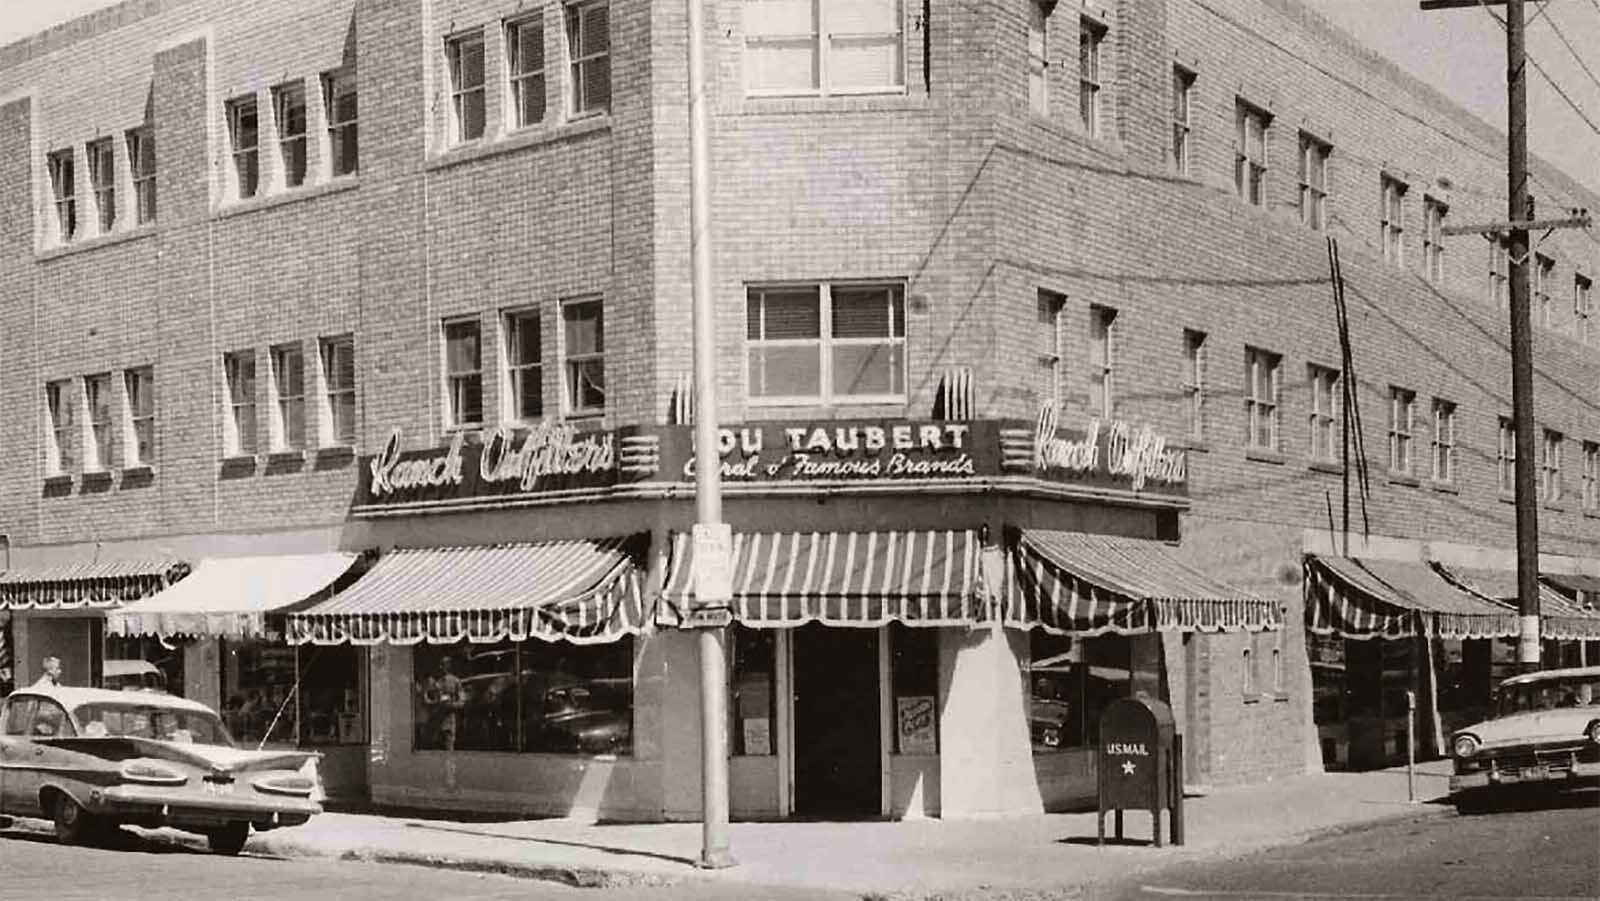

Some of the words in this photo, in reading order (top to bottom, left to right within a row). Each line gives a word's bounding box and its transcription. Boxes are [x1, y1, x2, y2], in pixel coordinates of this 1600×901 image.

[370, 427, 464, 496] Ranch
[480, 420, 615, 491] Outfitters
[692, 427, 763, 452] OU
[785, 424, 969, 451] TAUBERT
[1034, 400, 1099, 470] Ranch
[683, 455, 757, 478] Cral
[792, 453, 880, 477] Famous
[886, 452, 975, 477] Brands
